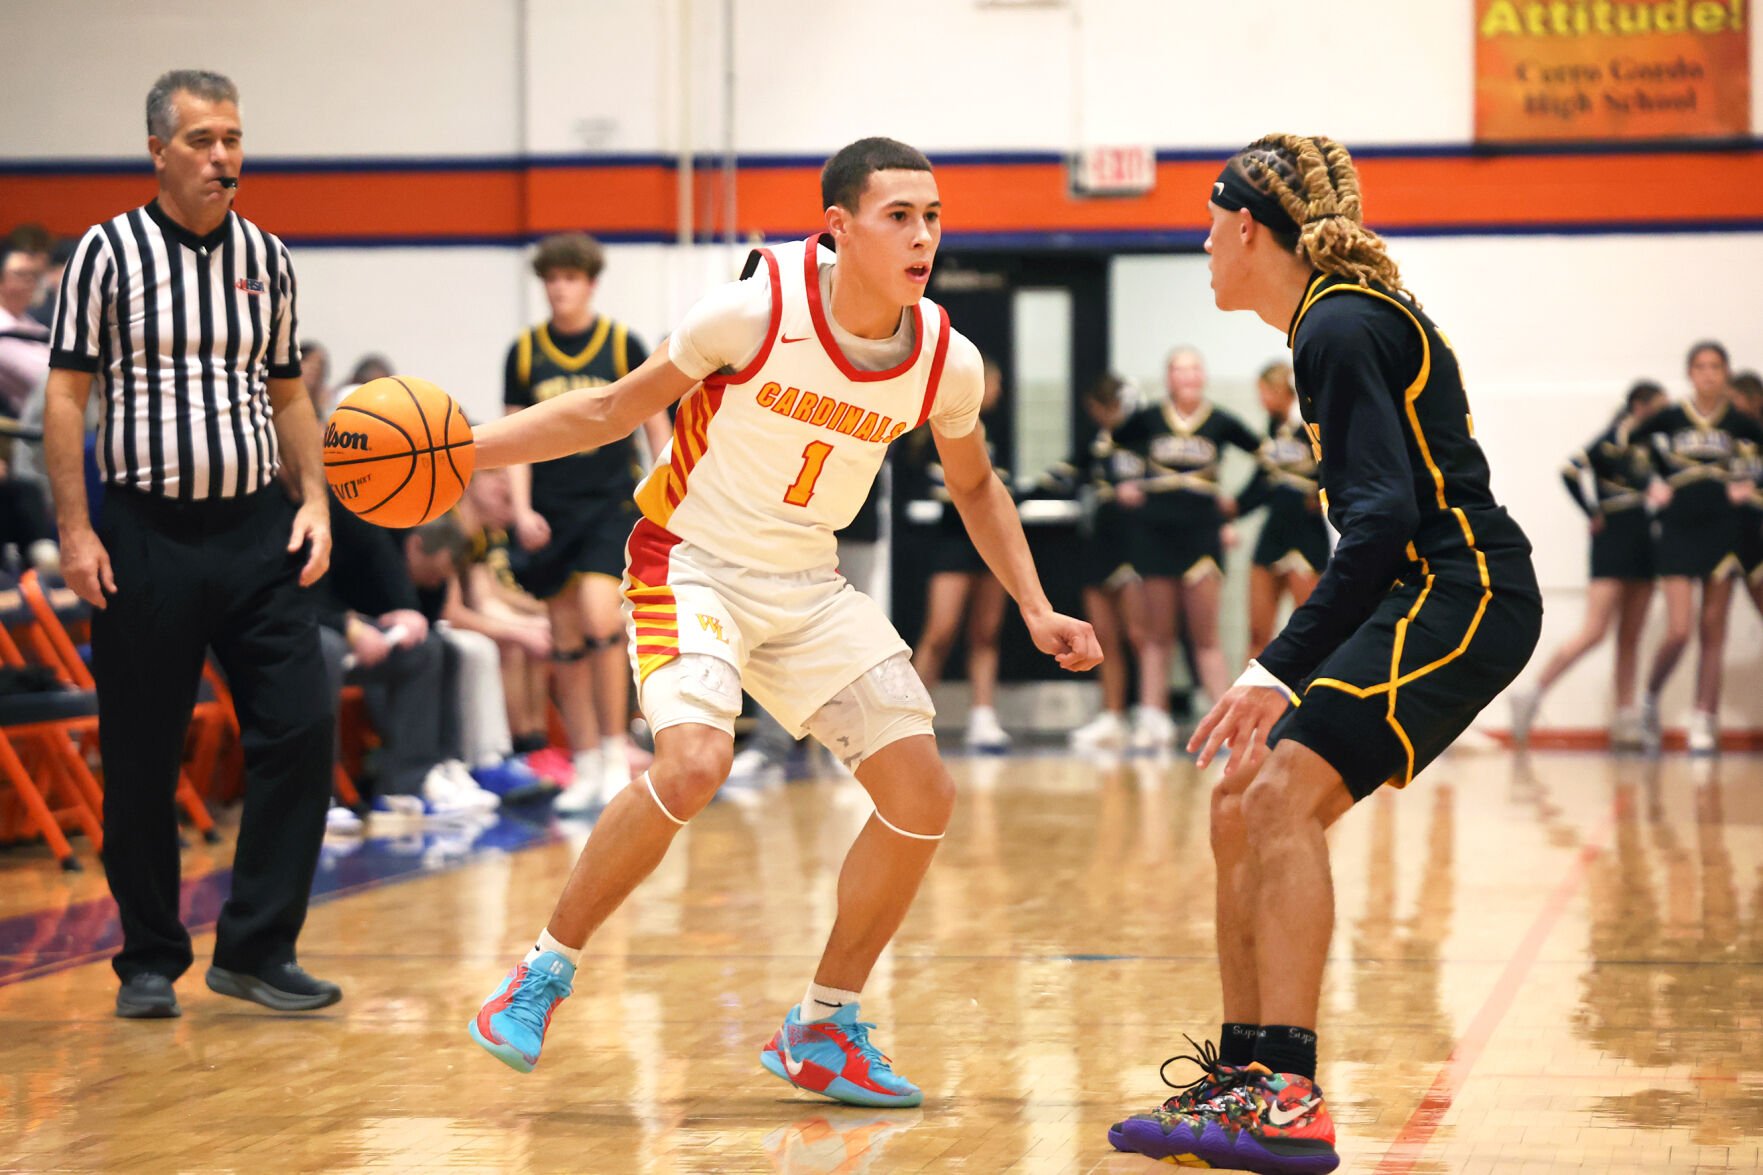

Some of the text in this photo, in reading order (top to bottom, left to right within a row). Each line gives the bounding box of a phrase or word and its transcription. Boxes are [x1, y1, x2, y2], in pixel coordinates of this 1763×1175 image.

[1481, 0, 1743, 36] Attitude!
[1524, 87, 1697, 120] High School
[755, 381, 907, 444] CARDINALS
[324, 422, 369, 451] ilson
[783, 440, 834, 508] 1
[695, 613, 729, 645] WL
